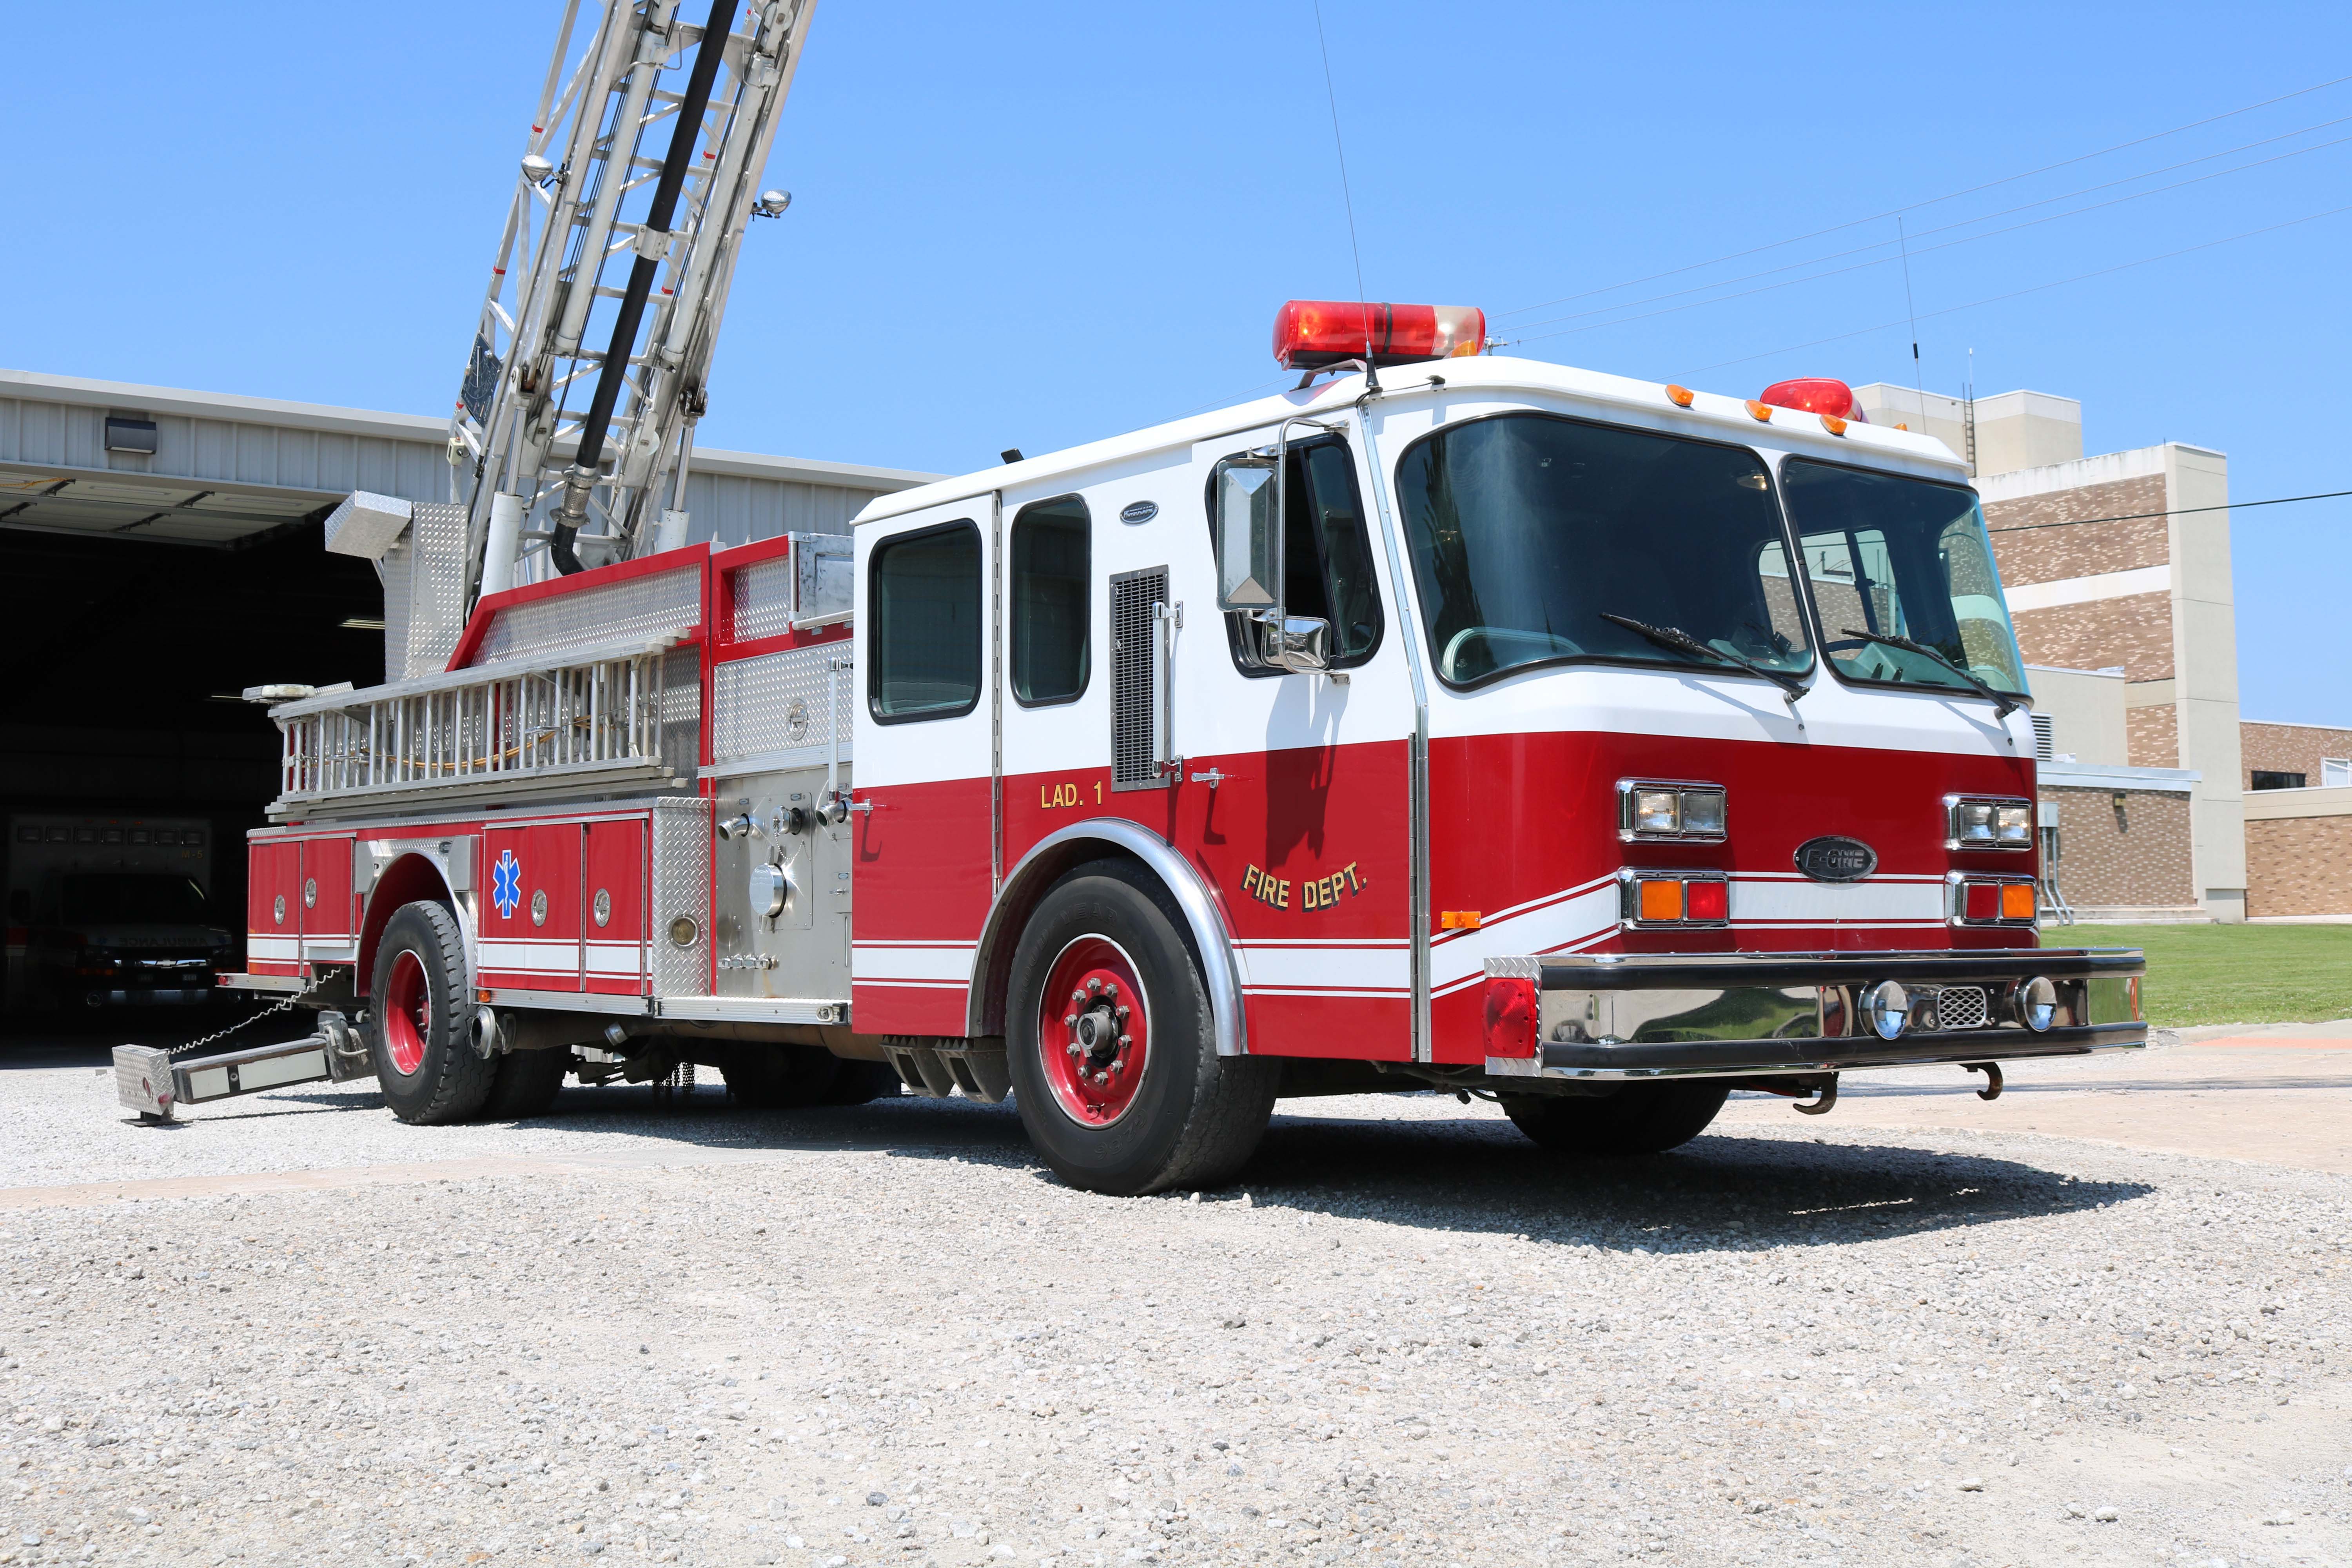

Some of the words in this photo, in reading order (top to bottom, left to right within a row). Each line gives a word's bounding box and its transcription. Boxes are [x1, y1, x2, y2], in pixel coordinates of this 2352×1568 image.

[1041, 782, 1084, 809] LAD.
[1094, 780, 1102, 805] 1
[181, 849, 203, 859] M-5
[1806, 849, 1864, 869] E-ONE
[1241, 864, 1290, 911] FIRE
[1302, 861, 1367, 913] DEPT.
